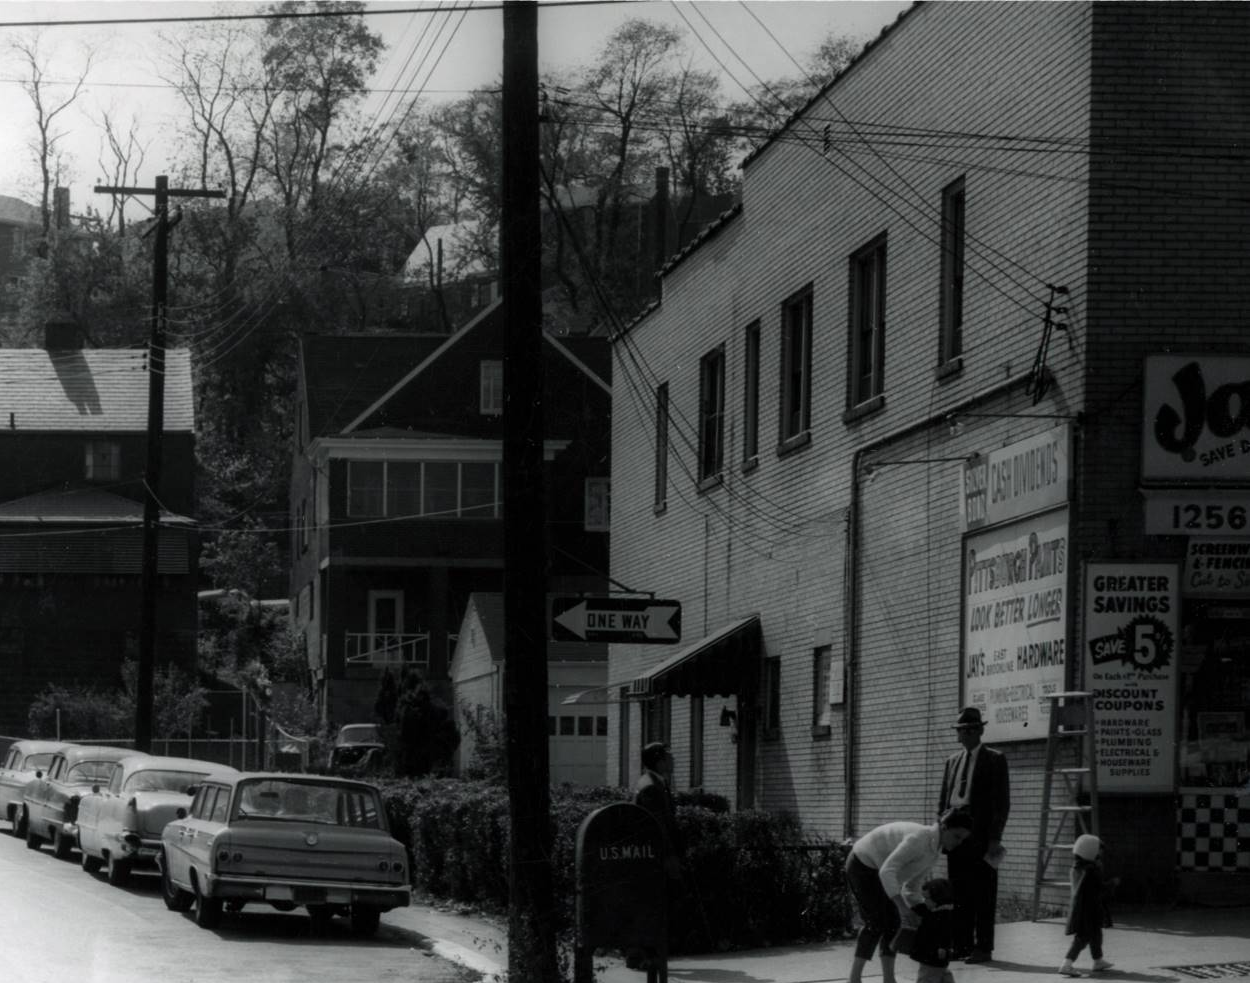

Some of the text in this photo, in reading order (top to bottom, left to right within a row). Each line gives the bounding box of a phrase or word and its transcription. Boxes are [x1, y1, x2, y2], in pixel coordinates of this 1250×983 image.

[1199, 443, 1236, 467] SAVE
[991, 440, 1058, 504] CASH DIVIDENDS
[1173, 504, 1247, 530] 1256
[1093, 575, 1169, 592] GREATER
[970, 588, 1063, 632] LOOK BETTER LONGER
[1093, 595, 1171, 613] SAVINGS
[587, 613, 650, 629] ONE WAY
[1017, 638, 1065, 671] HARDWARE
[1094, 639, 1127, 659] SAVE
[1093, 688, 1159, 699] DISCOUNT
[1095, 700, 1165, 711] COUPONS
[1100, 718, 1151, 727] HARDWARE
[1100, 738, 1152, 747] PLUMBING
[1100, 748, 1151, 757] ELECTRICAL
[1110, 768, 1151, 777] SUPPLIES
